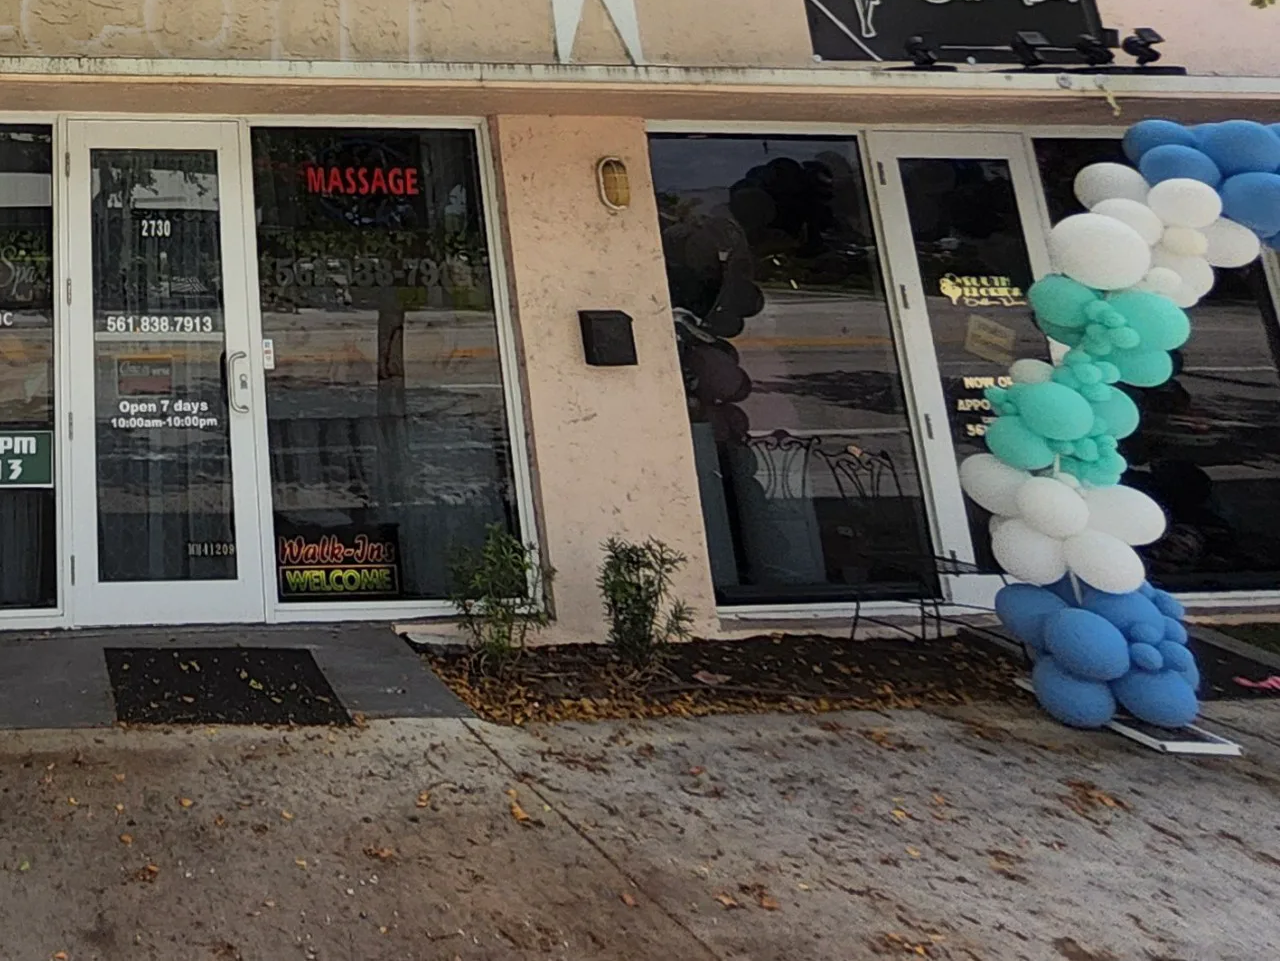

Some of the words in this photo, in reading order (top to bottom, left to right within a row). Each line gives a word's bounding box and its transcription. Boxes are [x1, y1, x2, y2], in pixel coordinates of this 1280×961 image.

[307, 167, 420, 195] MASSAGE
[141, 219, 171, 237] 2730
[106, 315, 214, 333] 561.838.7913
[119, 400, 157, 415] Open
[160, 400, 170, 412] 7
[173, 399, 209, 415] days
[111, 415, 218, 429] 10:00am-10:00pm
[285, 568, 392, 592] WELCOME
